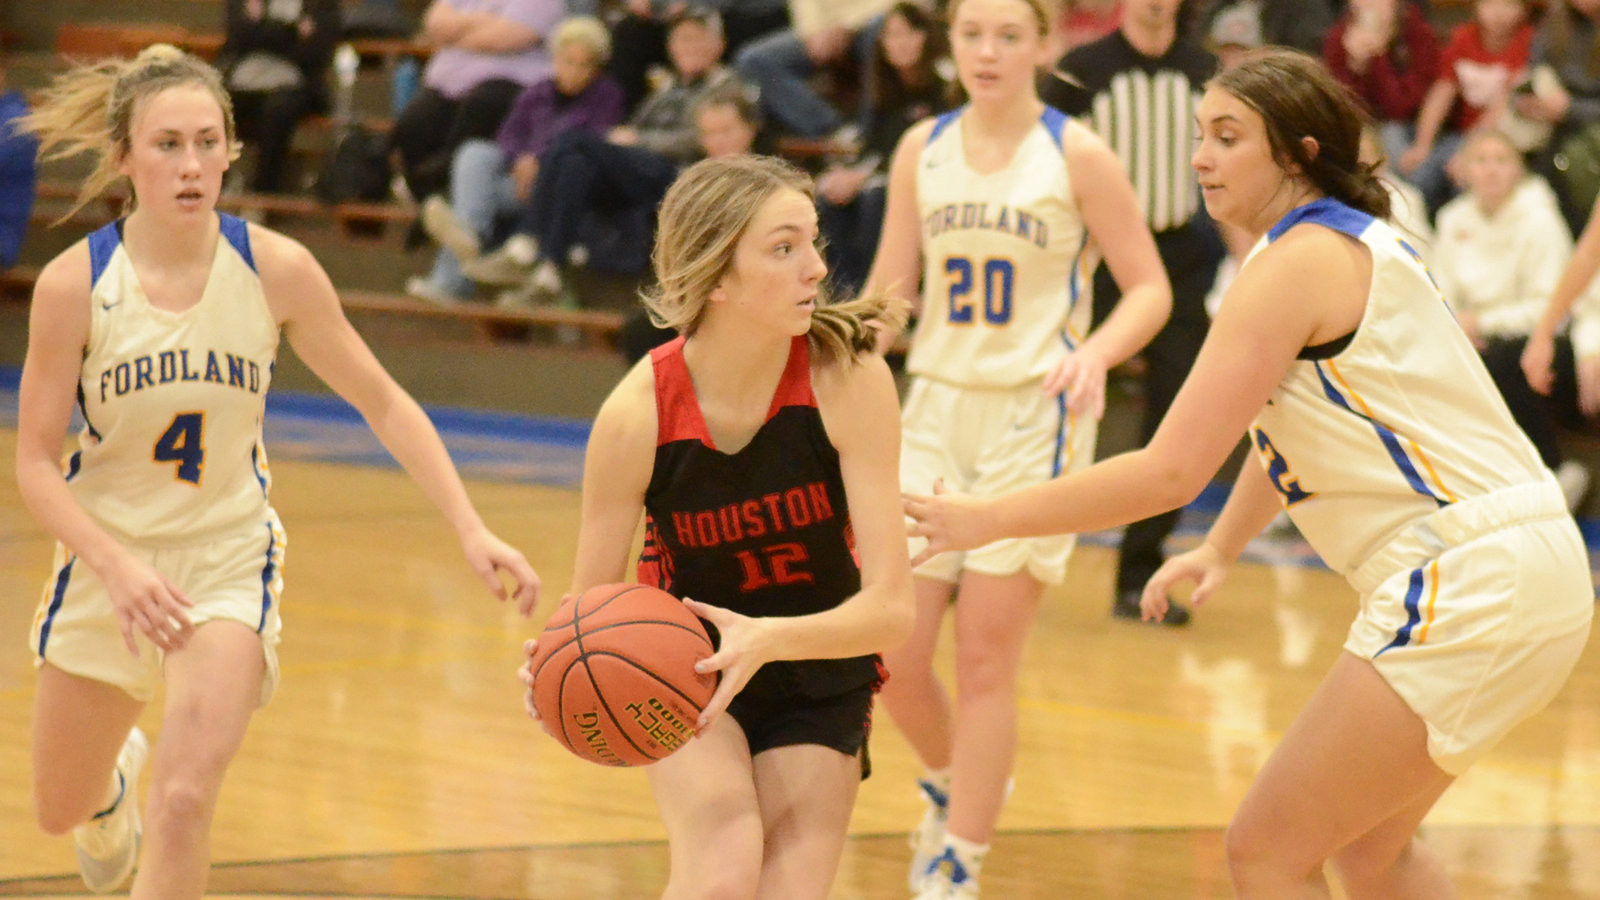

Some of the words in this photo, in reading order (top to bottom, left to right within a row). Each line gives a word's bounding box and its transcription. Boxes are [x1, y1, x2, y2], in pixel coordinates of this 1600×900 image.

[942, 255, 1015, 328] 20
[99, 348, 260, 403] FORDLAND
[152, 410, 207, 487] 4
[672, 481, 834, 548] HOUSTON
[734, 541, 815, 593] 12
[624, 702, 686, 752] EGACY
